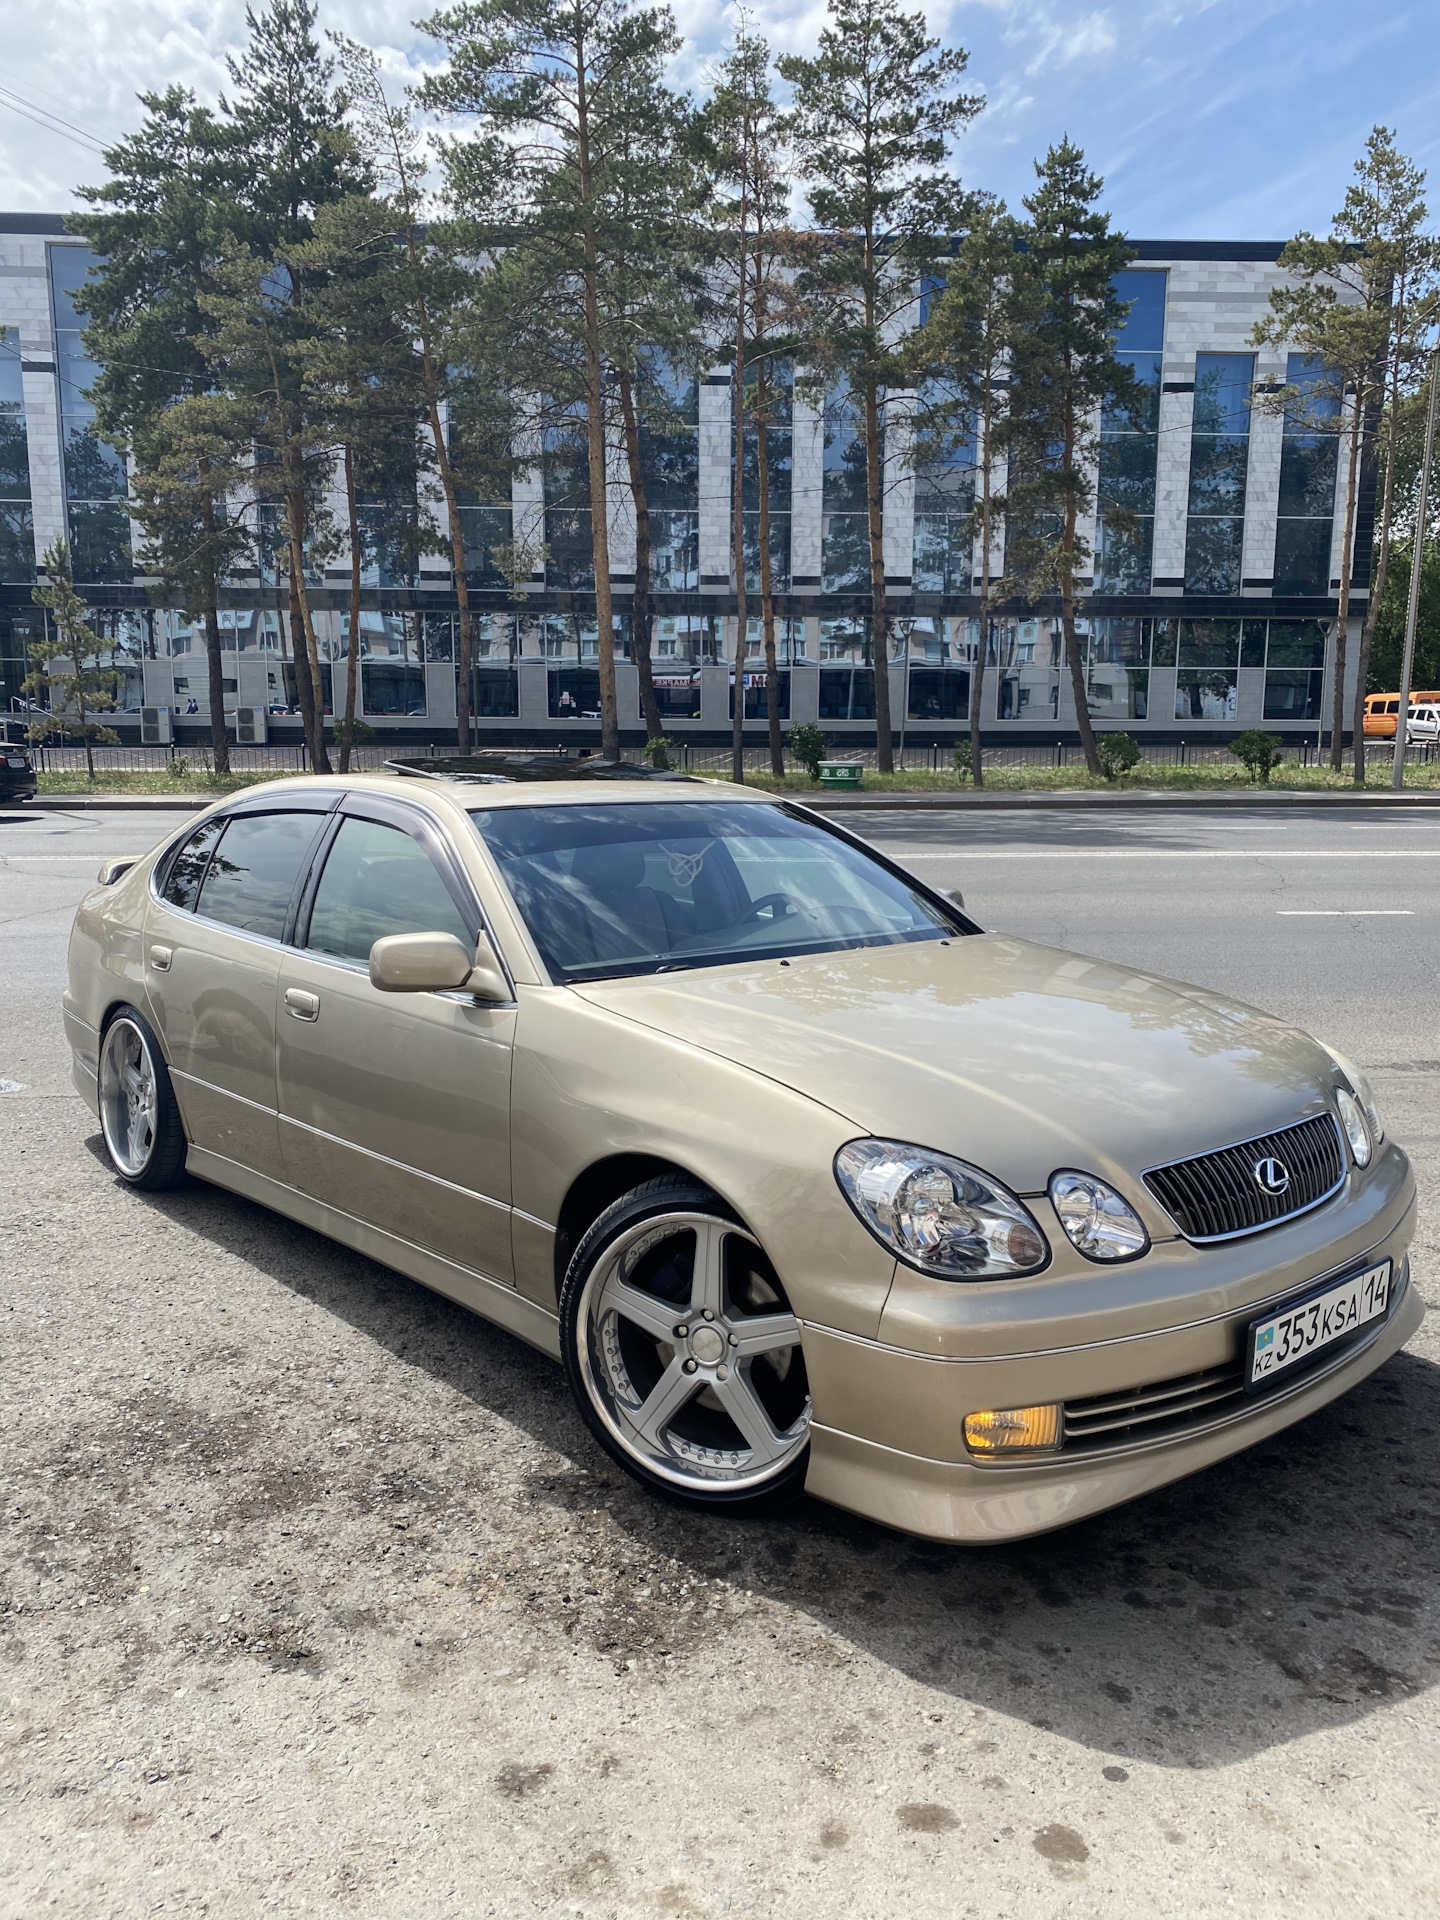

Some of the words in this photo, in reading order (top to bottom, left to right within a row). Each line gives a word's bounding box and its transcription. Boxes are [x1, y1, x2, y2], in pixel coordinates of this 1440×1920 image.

[1277, 1294, 1357, 1362] 353KSA
[1365, 1270, 1386, 1314] 14
[1255, 1351, 1273, 1375] KZ
